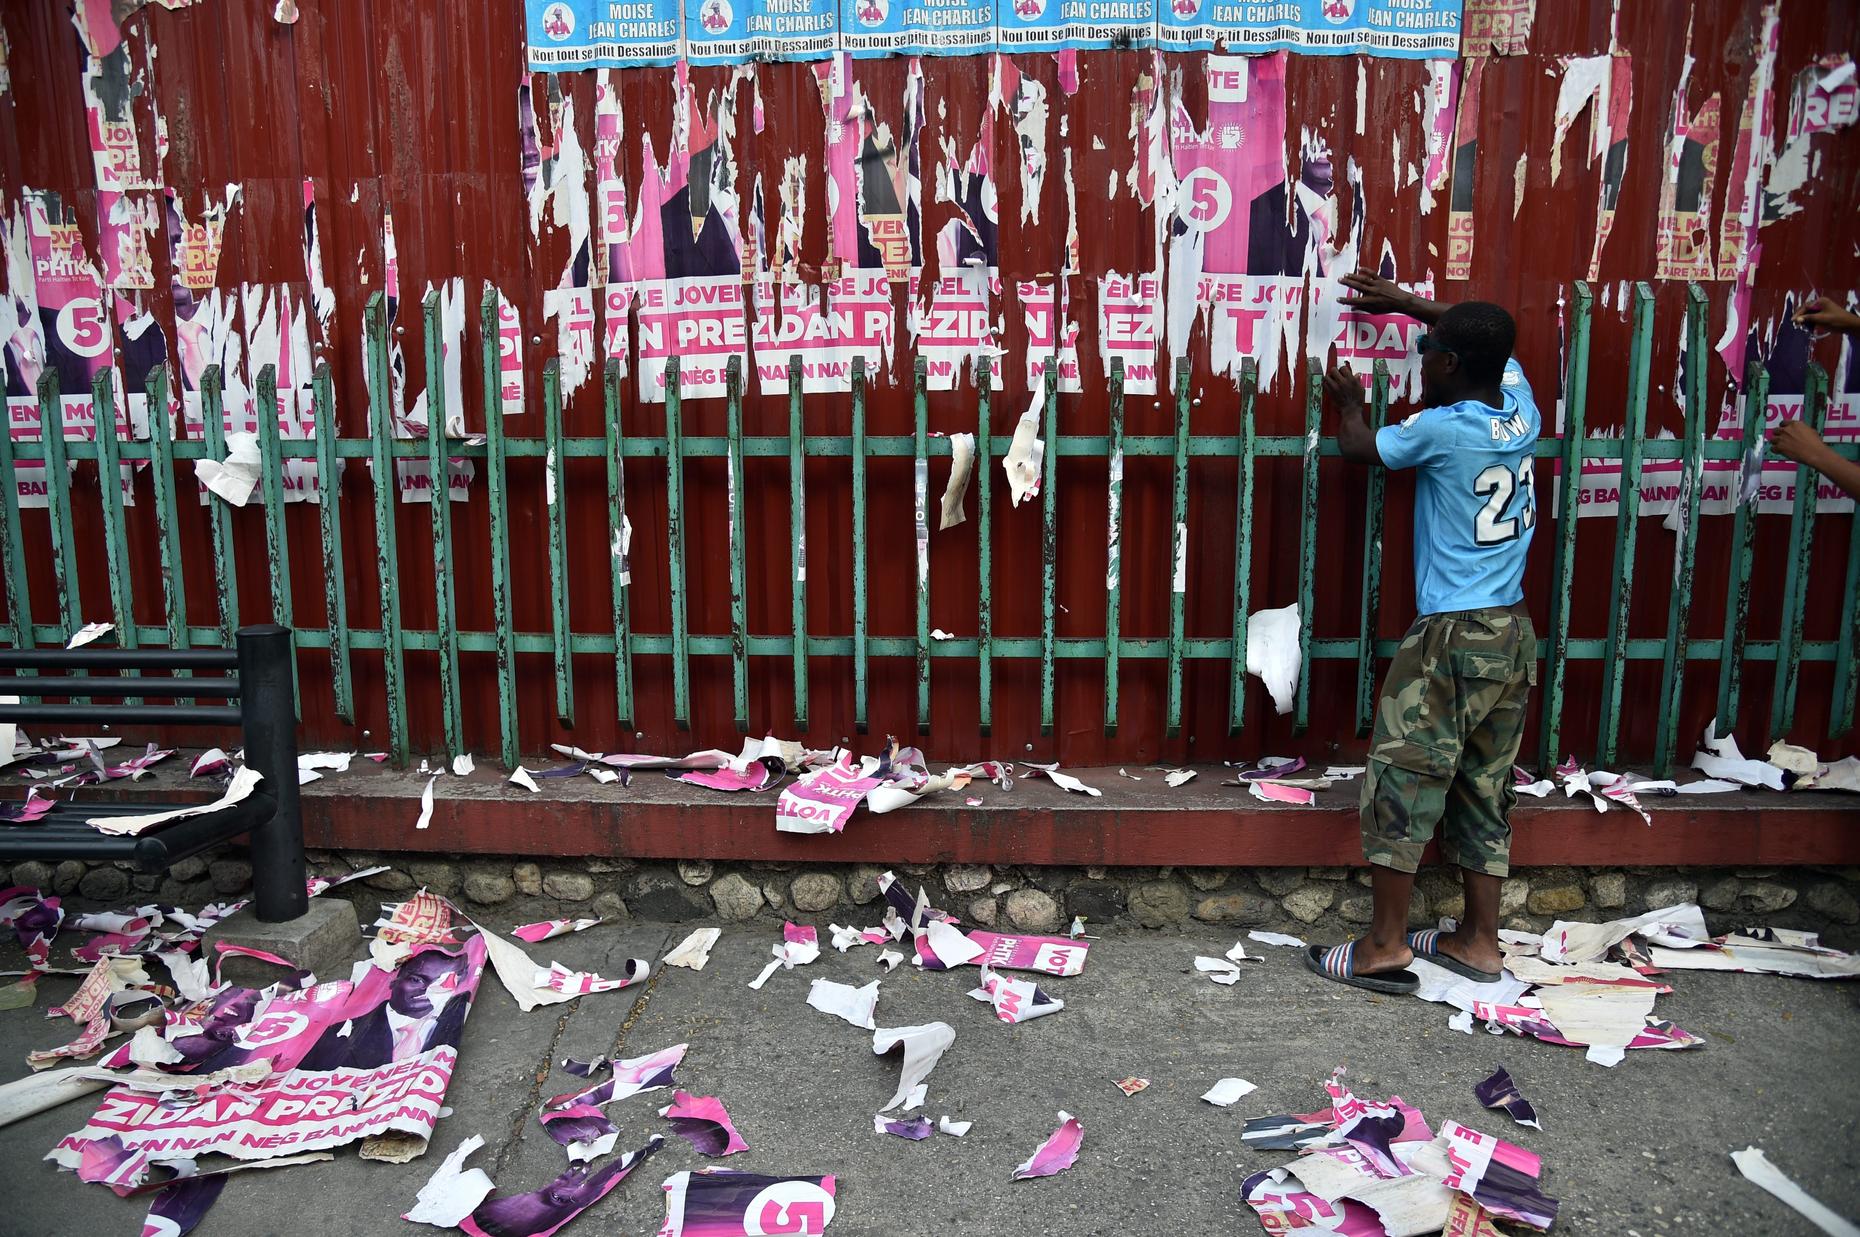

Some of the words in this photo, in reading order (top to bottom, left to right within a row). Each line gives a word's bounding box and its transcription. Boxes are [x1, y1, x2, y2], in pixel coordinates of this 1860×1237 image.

[609, 3, 654, 20] MOISE
[902, 8, 929, 26] JEAN
[932, 6, 992, 26] CHARLES
[1061, 2, 1087, 19] JEAN
[1090, 1, 1152, 19] CHARLES
[1212, 6, 1242, 22] JEAN
[1246, 4, 1301, 23] CHARLES
[1367, 8, 1392, 27] JEAN
[1395, 11, 1457, 29] CHARLES
[588, 22, 615, 40] JEAN
[619, 19, 677, 39] CHARLES
[746, 16, 772, 33] JEAN
[775, 12, 834, 33] CHARLES
[844, 35, 866, 48] Nou
[869, 36, 891, 47] tout
[894, 36, 906, 47] se
[931, 31, 992, 46] Dessalines
[1002, 30, 1022, 43] Nou
[1026, 30, 1048, 41] tout
[1052, 30, 1063, 40] se
[1065, 25, 1085, 39] pitit
[1088, 25, 1151, 40] Dessalines
[1161, 26, 1178, 41] Nou
[1181, 27, 1203, 41] tout
[1205, 28, 1215, 40] se
[1243, 27, 1300, 43] Dessalines
[1306, 32, 1328, 45] Nou
[1332, 32, 1354, 45] tout
[1357, 31, 1369, 43] se
[1392, 35, 1454, 48] Dessalines
[532, 48, 554, 62] Nou
[557, 48, 579, 61] tout
[582, 50, 593, 60] se
[617, 43, 677, 58] Dessalines
[690, 42, 711, 56] Nou
[714, 43, 736, 55] tout
[739, 44, 750, 54] se
[774, 37, 834, 52] Dessalines
[1189, 178, 1219, 221] 5
[72, 307, 103, 348] 5
[1473, 453, 1537, 548] 23
[776, 798, 830, 822] VOTE
[286, 1059, 426, 1090] JOVENEL
[240, 1132, 300, 1149] NÈG
[759, 1199, 824, 1235] 5
